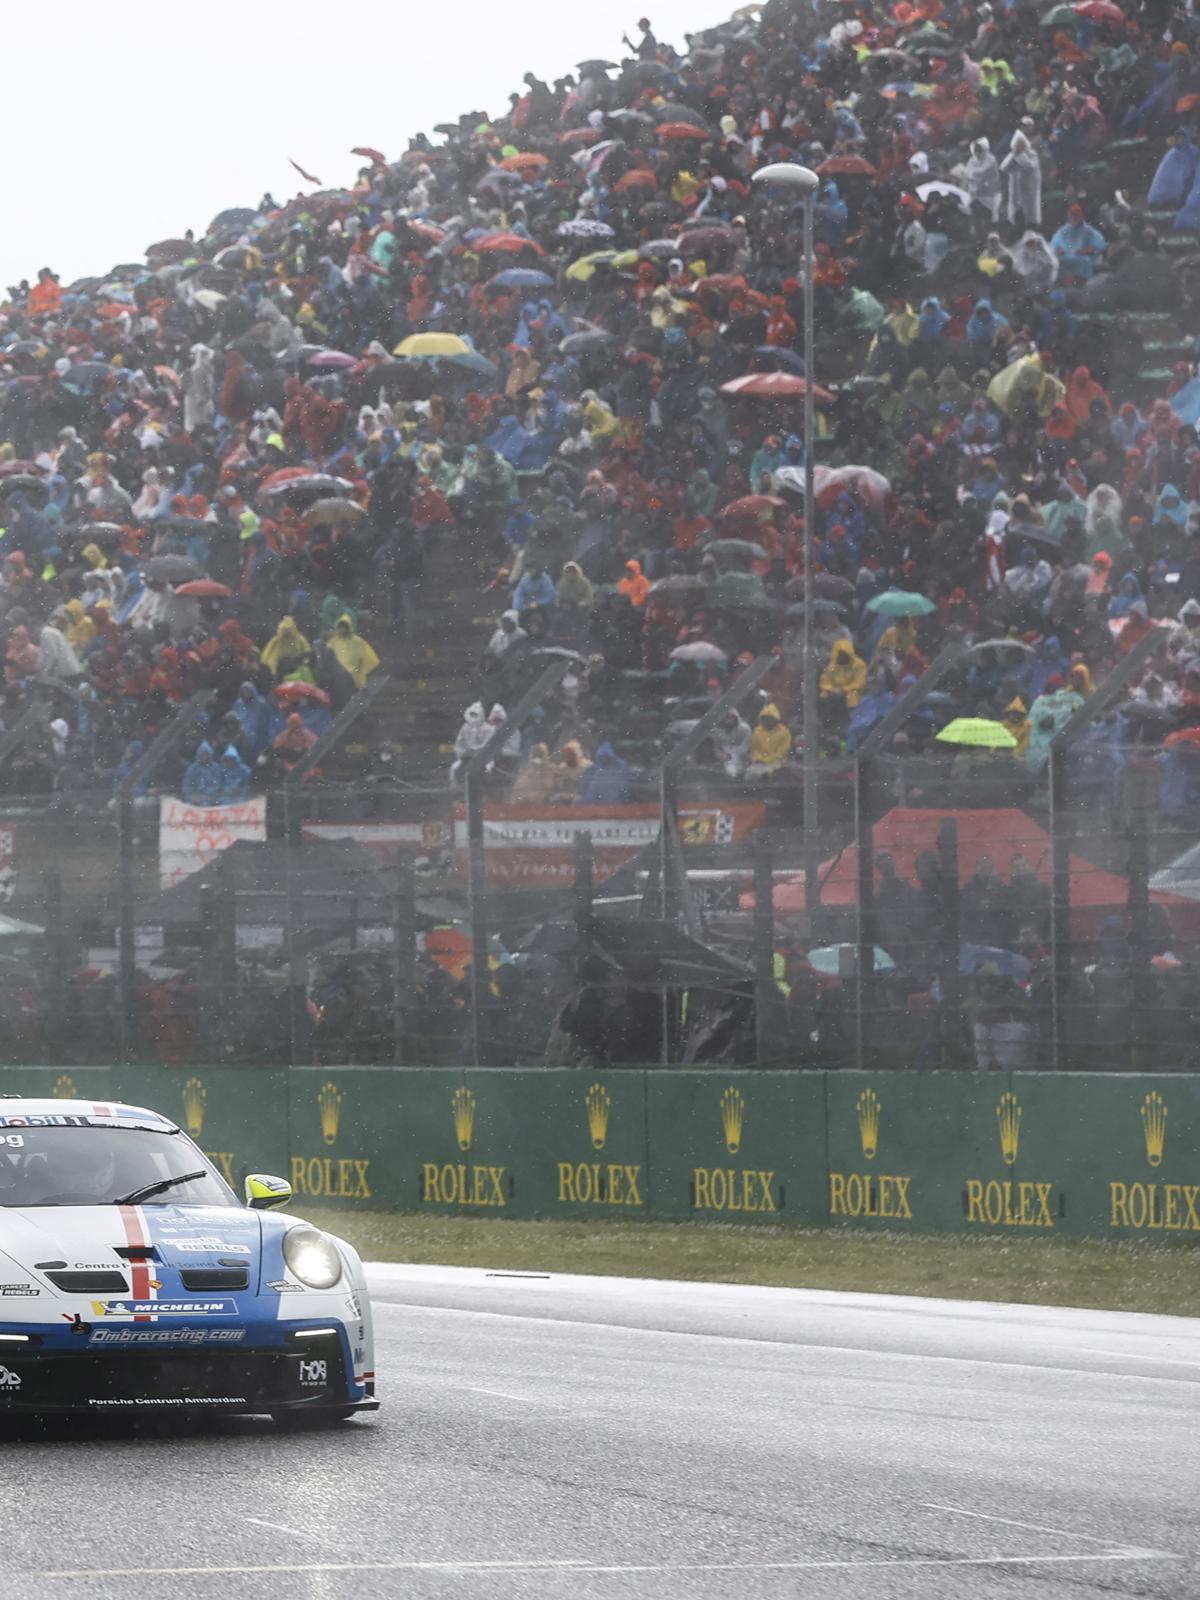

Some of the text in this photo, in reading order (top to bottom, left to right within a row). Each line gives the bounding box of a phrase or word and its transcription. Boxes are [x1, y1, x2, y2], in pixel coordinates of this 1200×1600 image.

[290, 1157, 371, 1198] ROLEX
[423, 1163, 506, 1206] ROLEX
[557, 1162, 643, 1206] ROLEX
[694, 1167, 776, 1212] ROLEX
[829, 1173, 913, 1220] ROLEX
[966, 1179, 1055, 1228] ROLEX
[1110, 1182, 1200, 1231] ROLEX
[134, 1303, 224, 1312] MICHELIN
[90, 1327, 246, 1343] Ombraracing.com
